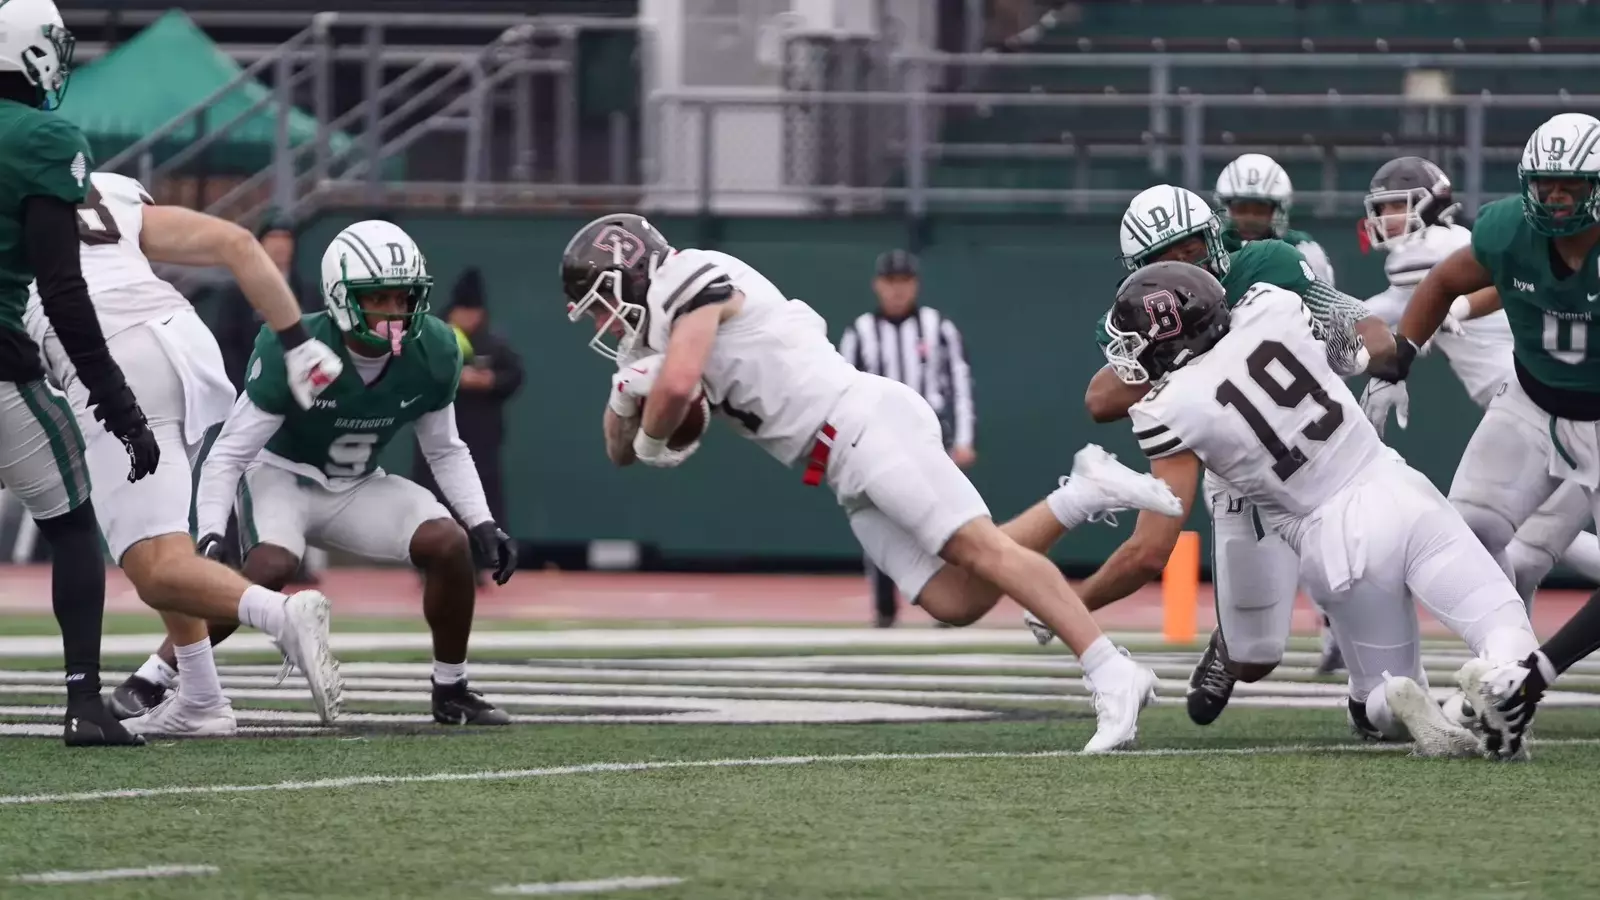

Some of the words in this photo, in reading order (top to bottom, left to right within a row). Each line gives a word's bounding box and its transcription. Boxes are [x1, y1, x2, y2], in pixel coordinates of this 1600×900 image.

[1549, 137, 1566, 161] D
[1246, 168, 1260, 186] D
[1148, 206, 1171, 233] D
[386, 242, 406, 266] D
[593, 225, 646, 268] B
[1143, 289, 1183, 340] B
[334, 417, 395, 428] DARTMOUTH
[1215, 339, 1344, 482] 19
